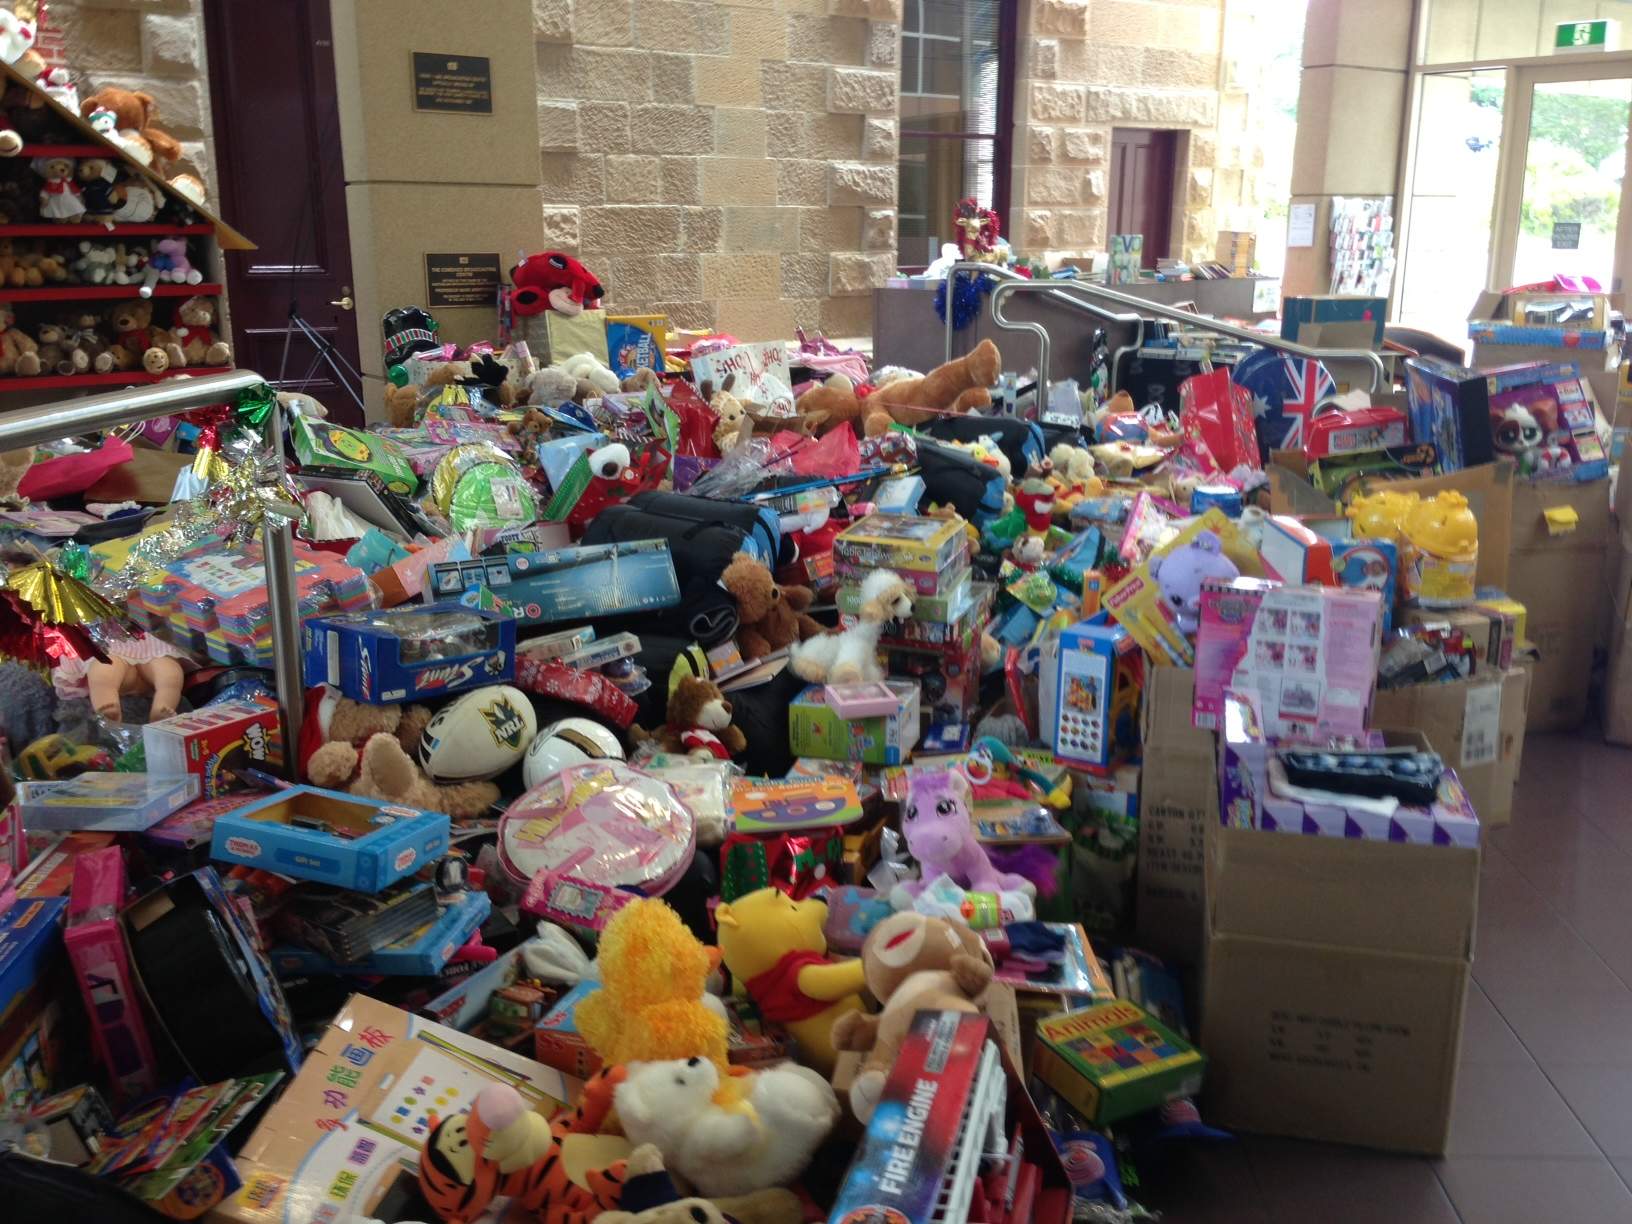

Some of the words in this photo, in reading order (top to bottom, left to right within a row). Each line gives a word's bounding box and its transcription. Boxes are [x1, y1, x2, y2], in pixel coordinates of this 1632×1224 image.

[245, 722, 265, 761] WOW
[495, 716, 525, 743] NRL
[1043, 1005, 1141, 1042] Animals
[315, 1025, 396, 1132] 多功能画板
[897, 1077, 940, 1149] ENGINE
[878, 1143, 917, 1197] FIRE
